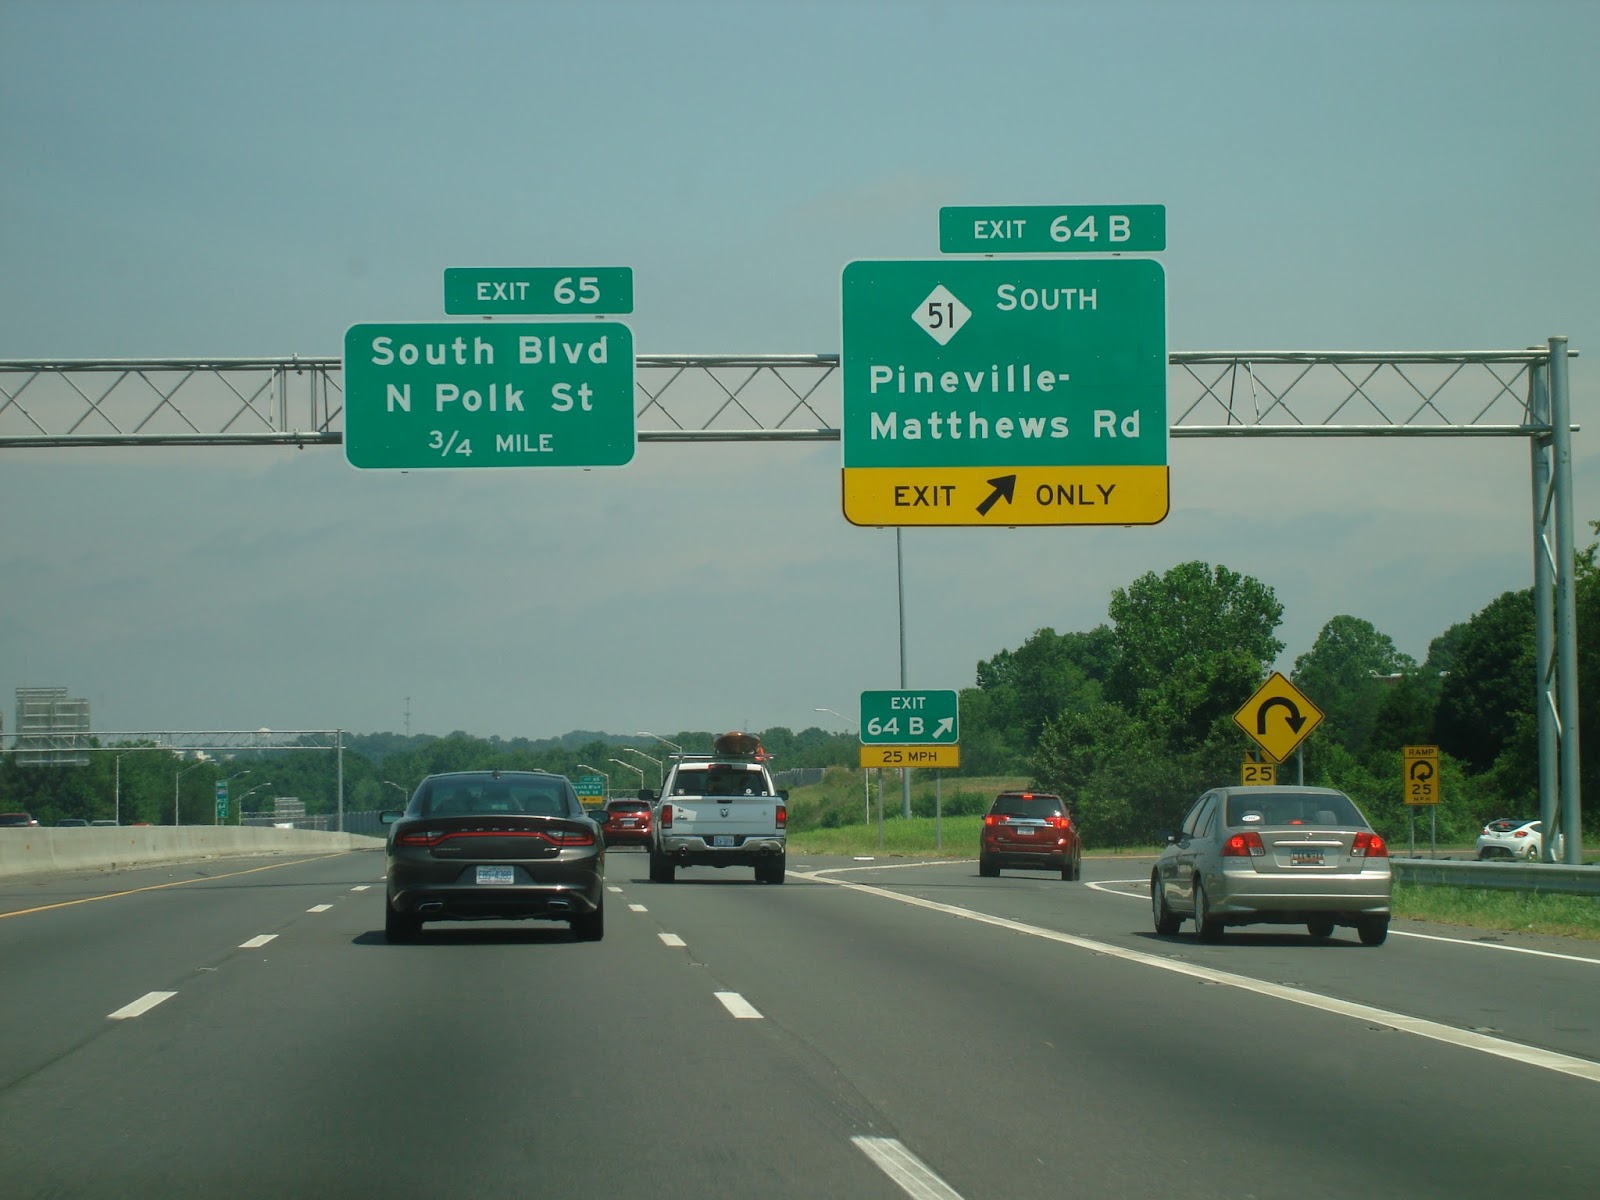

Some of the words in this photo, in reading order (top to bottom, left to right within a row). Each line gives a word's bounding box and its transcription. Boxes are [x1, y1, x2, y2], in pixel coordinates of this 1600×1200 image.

[973, 220, 1027, 239] EXIT
[1049, 215, 1099, 242] 64
[1108, 215, 1132, 242] B
[476, 281, 531, 301] EXIT
[553, 276, 601, 305] 65
[927, 302, 955, 329] 51
[371, 336, 495, 366] South
[518, 335, 609, 365] Blvd
[869, 364, 1071, 394] Pineville-
[386, 384, 412, 412] N
[435, 383, 525, 412] Polk
[551, 382, 594, 412] St
[869, 411, 1071, 440] Matthews
[1093, 409, 1141, 438] Rd
[428, 430, 473, 457] 3/4
[496, 434, 554, 453] MILE
[893, 485, 957, 507] EXIT
[1035, 483, 1117, 506] ONLY
[891, 697, 926, 710] EXIT
[867, 717, 900, 736] 64
[909, 717, 925, 735] B
[882, 751, 903, 763] 25
[908, 751, 937, 762] MPH
[1408, 748, 1434, 756] RAMP
[1245, 767, 1272, 781] 25
[1412, 784, 1432, 795] 25
